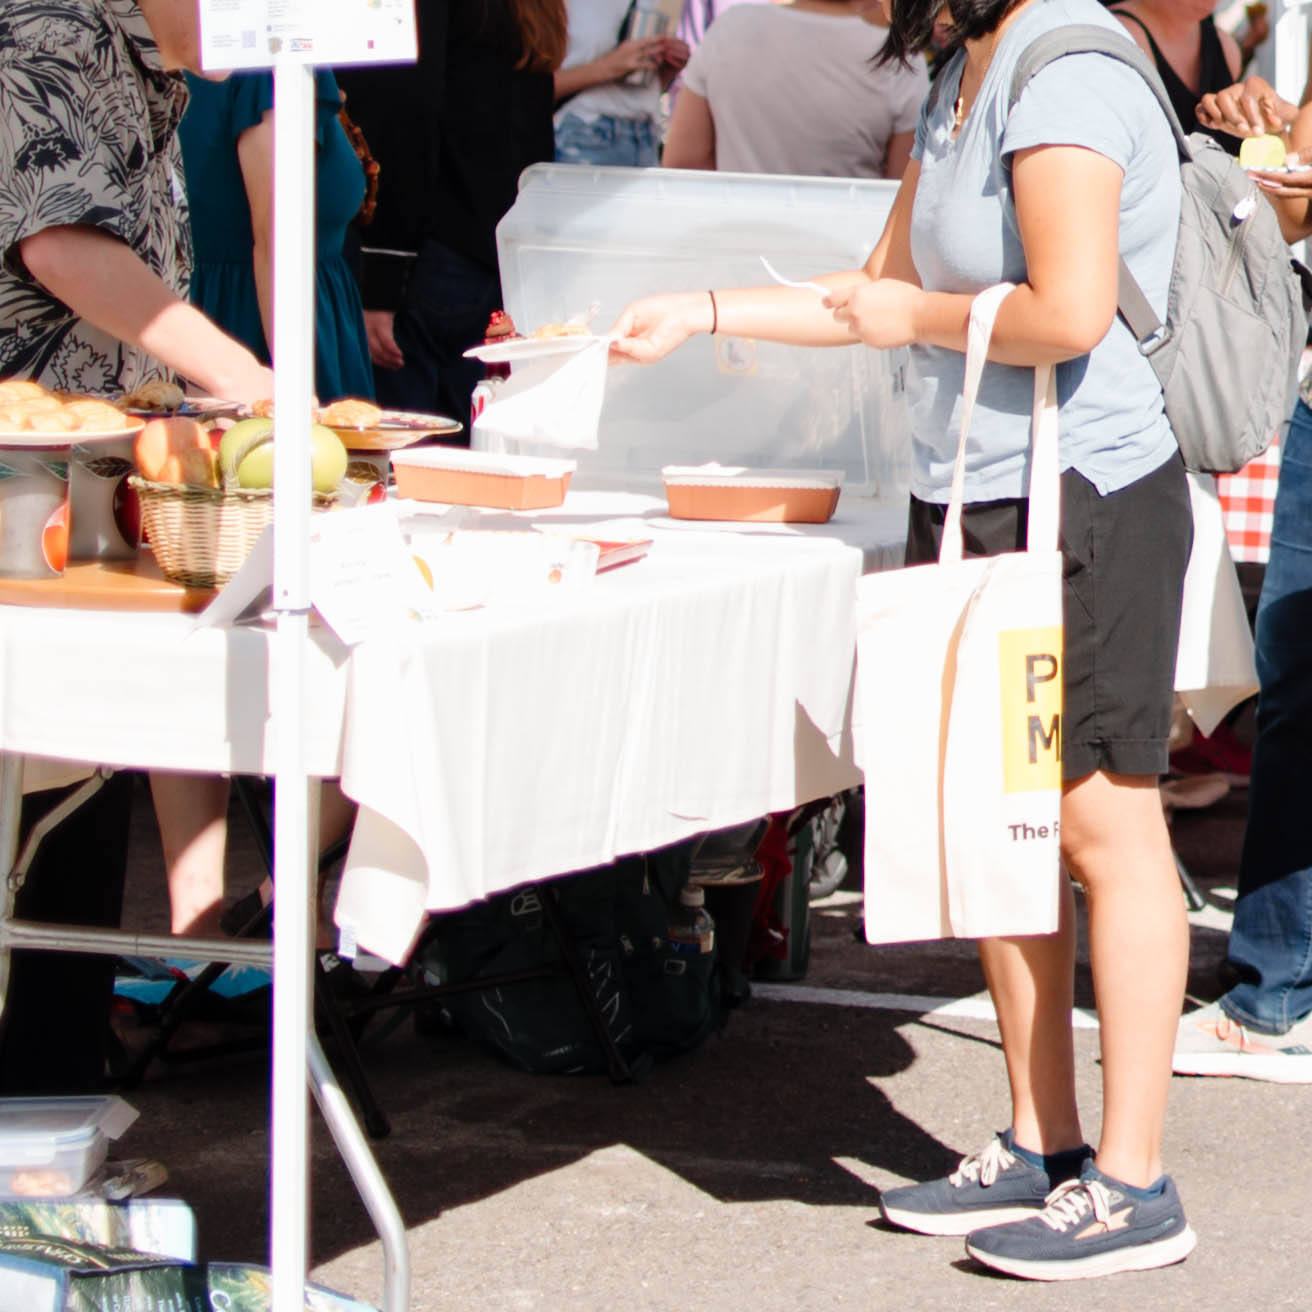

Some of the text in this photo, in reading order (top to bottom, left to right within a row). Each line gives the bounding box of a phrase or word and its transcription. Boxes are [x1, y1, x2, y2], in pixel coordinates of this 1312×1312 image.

[1025, 653, 1058, 703] P
[1027, 713, 1061, 764] M
[1008, 823, 1049, 841] The
